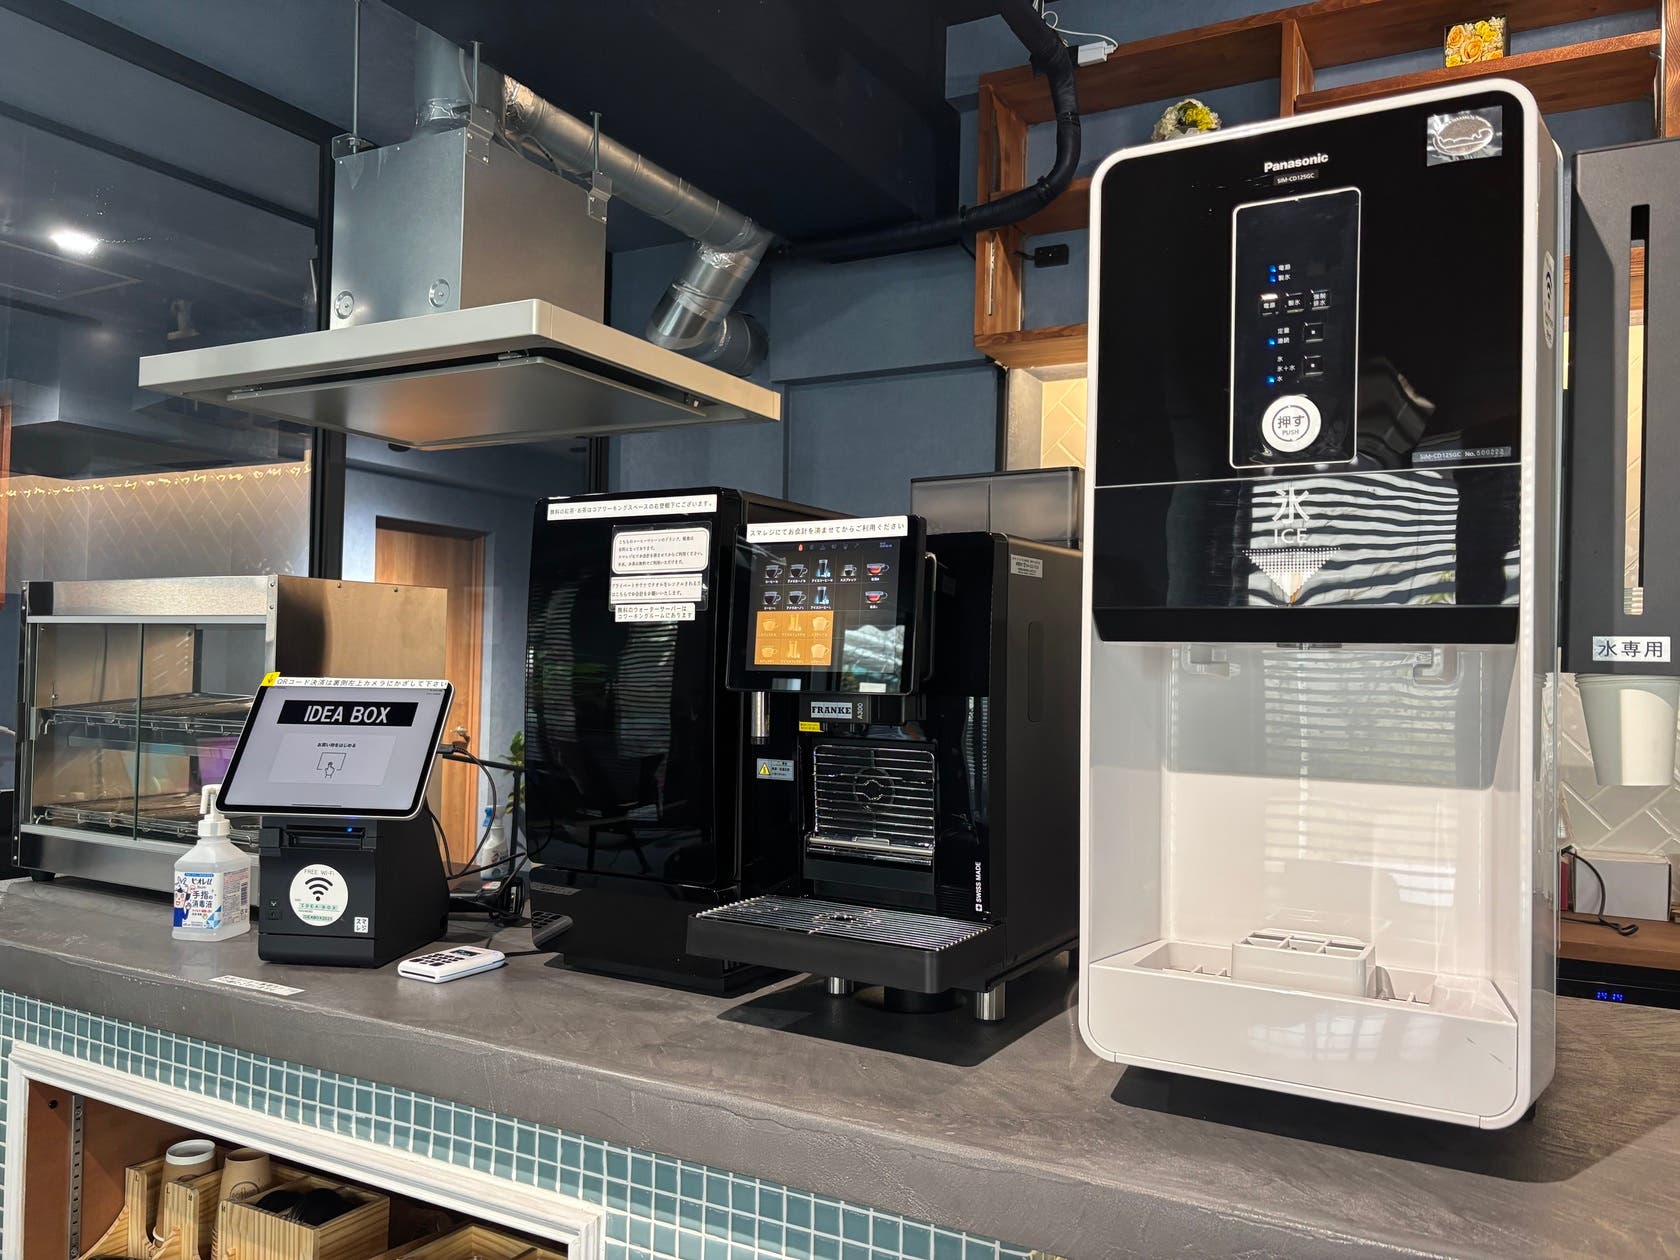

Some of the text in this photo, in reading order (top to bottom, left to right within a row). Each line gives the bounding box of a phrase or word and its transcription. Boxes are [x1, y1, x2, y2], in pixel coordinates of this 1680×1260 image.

[1264, 153, 1329, 173] Panasonic
[1277, 172, 1315, 184] SIM-CD125GC
[1278, 415, 1305, 429] 押す
[1271, 487, 1310, 523] 氷
[750, 522, 905, 537] スマレジにてお会計を済ませてからご利用ください
[1274, 528, 1307, 544] ICE
[1598, 641, 1663, 657] 水専用
[277, 679, 448, 688] QRコード決済は裏側左上カメラにかざして下さい
[303, 705, 391, 723] IDEA BOX
[811, 706, 852, 714] FRANKE
[192, 890, 214, 900] 手指の
[191, 900, 213, 909] 消毒液
